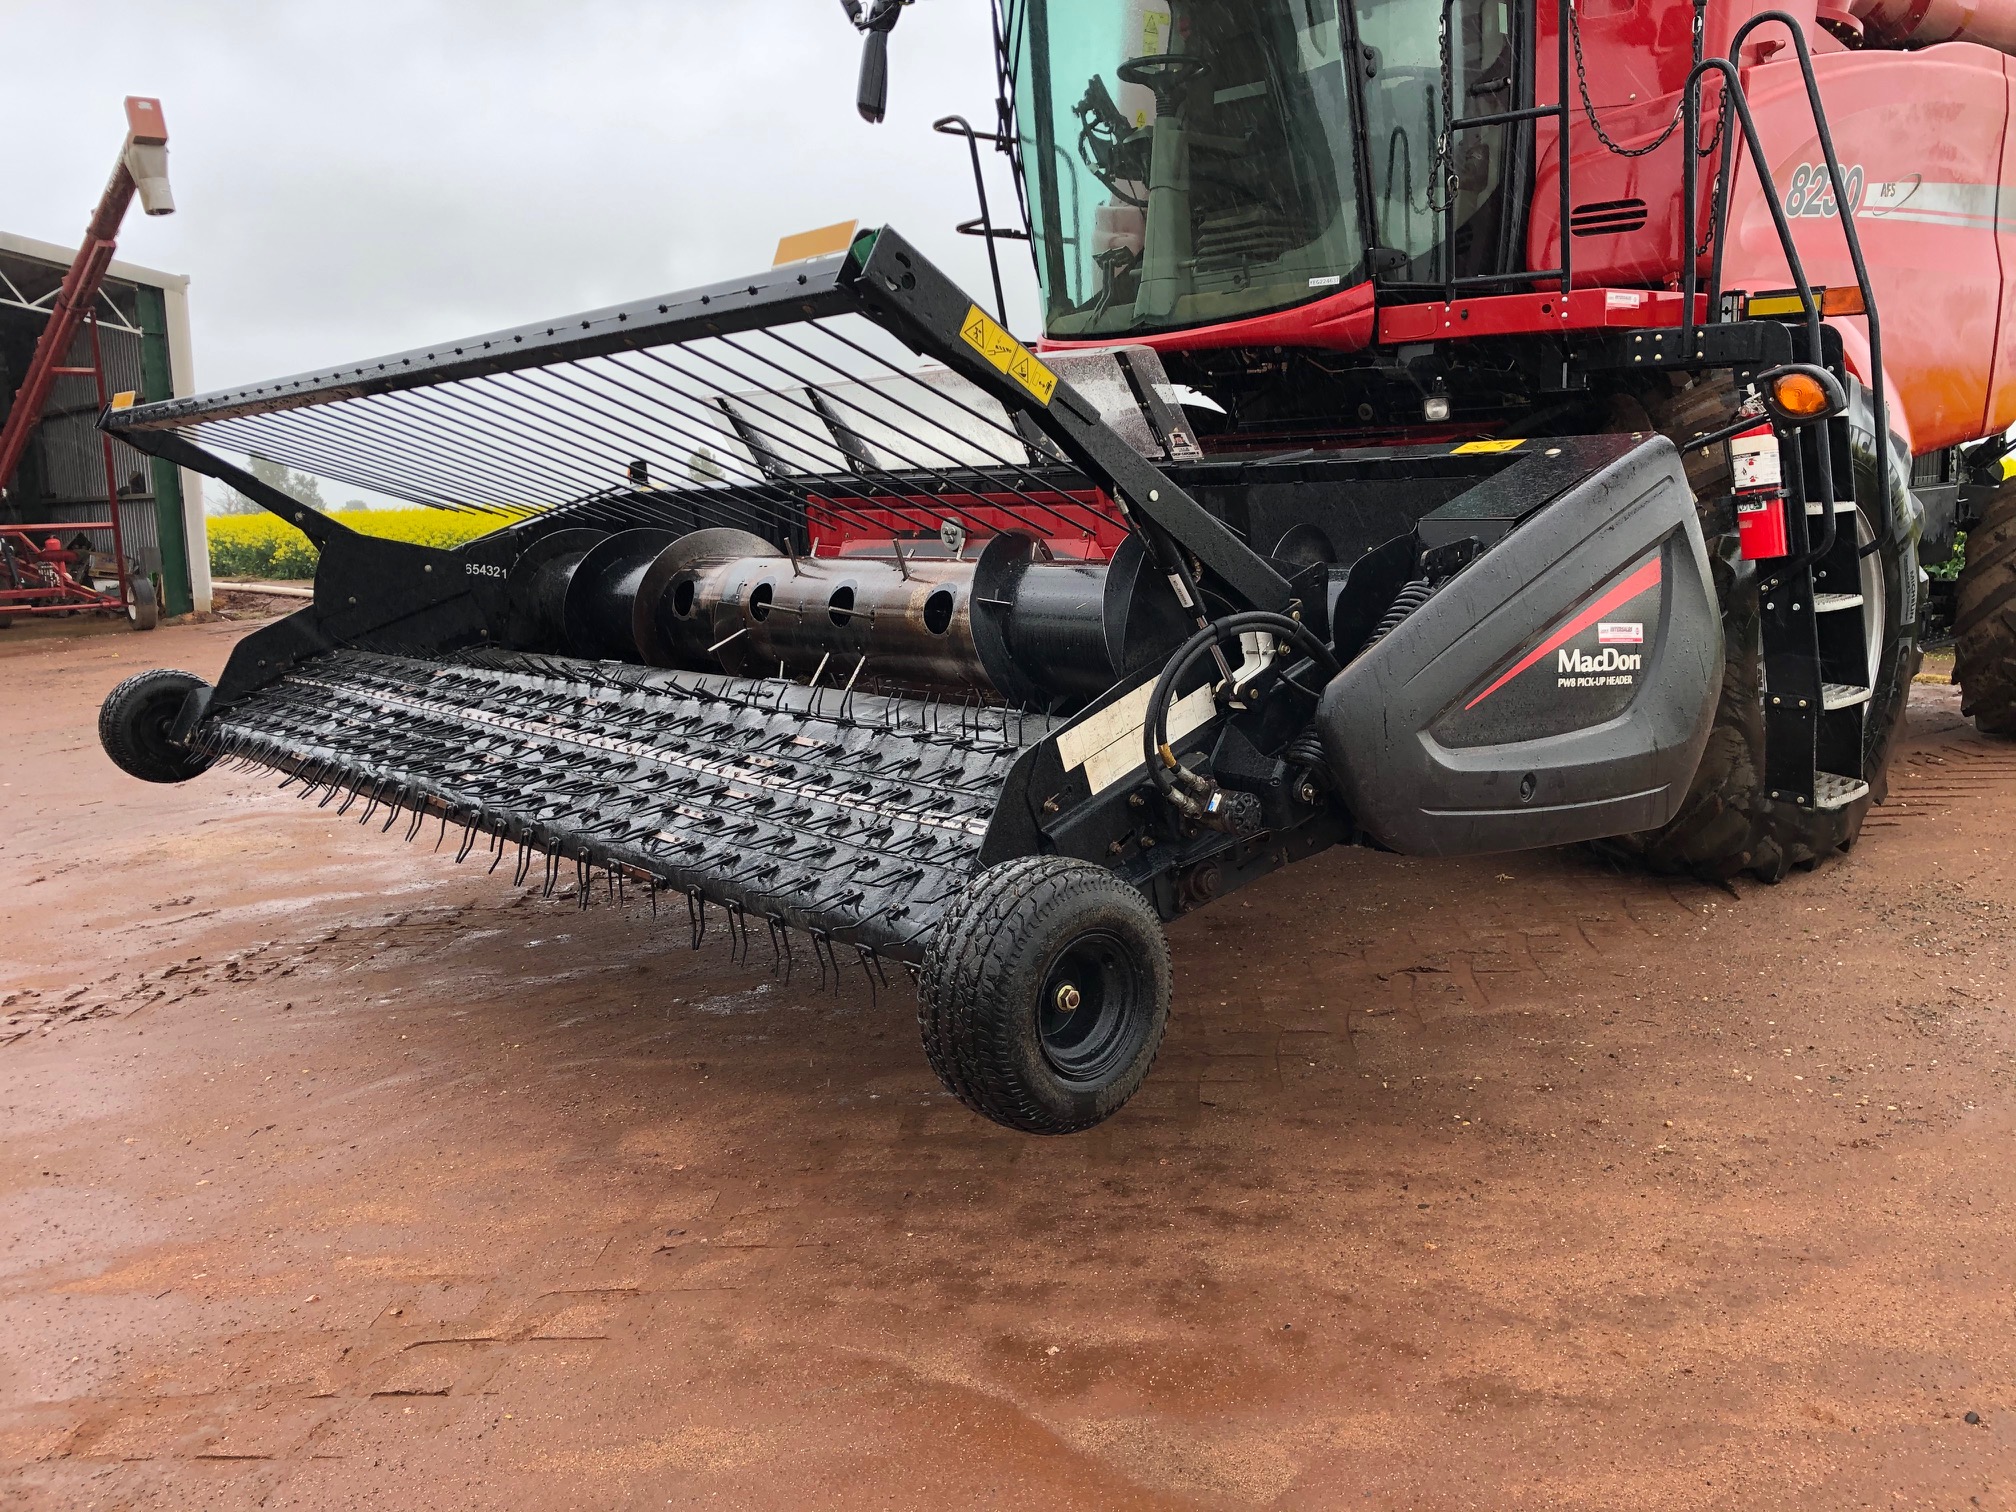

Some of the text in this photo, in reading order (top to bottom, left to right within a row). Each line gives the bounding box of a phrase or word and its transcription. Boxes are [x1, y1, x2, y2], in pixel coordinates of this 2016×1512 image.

[1785, 162, 1864, 218] 8230
[1880, 183, 1896, 198] AFS
[465, 563, 507, 579] 654321
[1557, 648, 1641, 673] MacDon
[1557, 675, 1633, 688] PW8 PICK-UP HEADER
